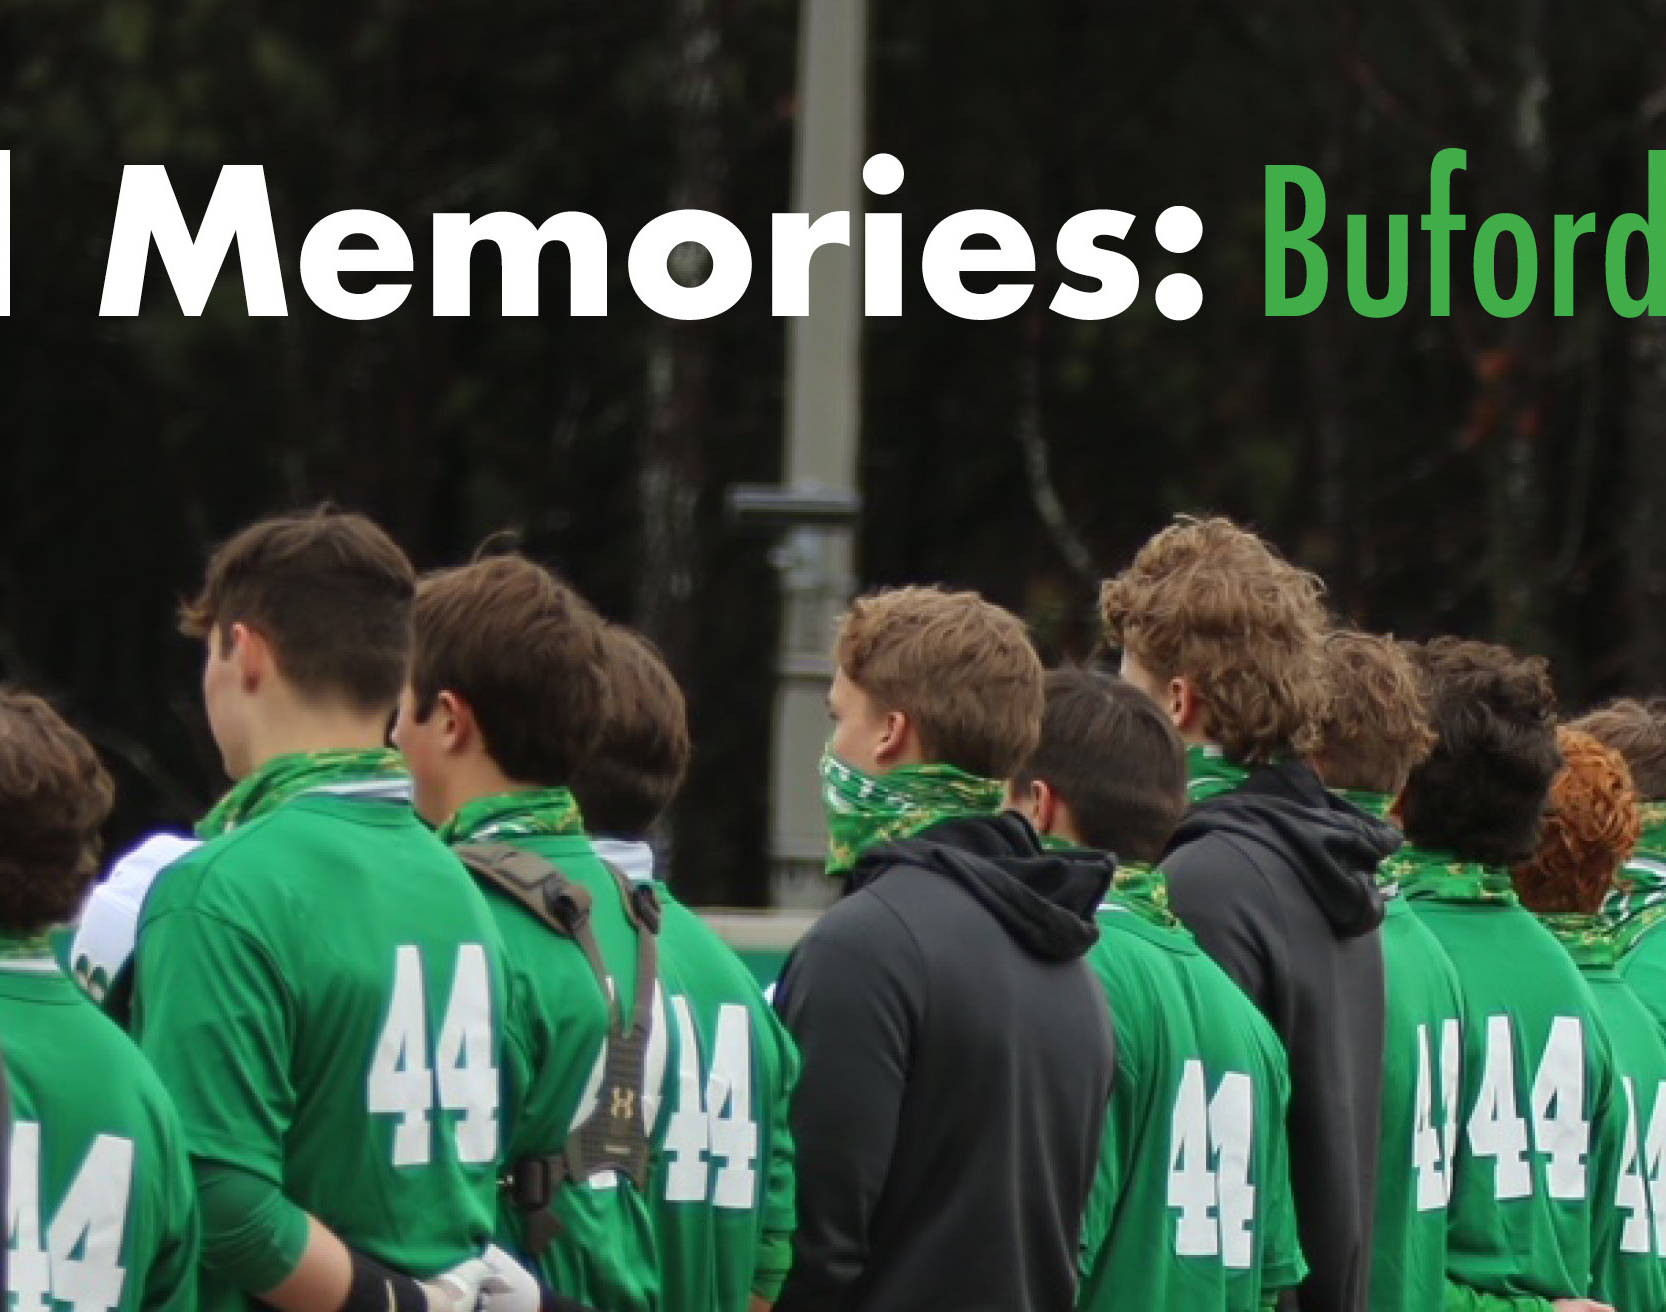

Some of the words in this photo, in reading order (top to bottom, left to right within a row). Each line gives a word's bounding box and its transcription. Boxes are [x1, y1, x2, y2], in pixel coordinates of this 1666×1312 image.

[367, 944, 499, 1166] 44
[663, 995, 757, 1209] 44
[1466, 1015, 1591, 1199] 44
